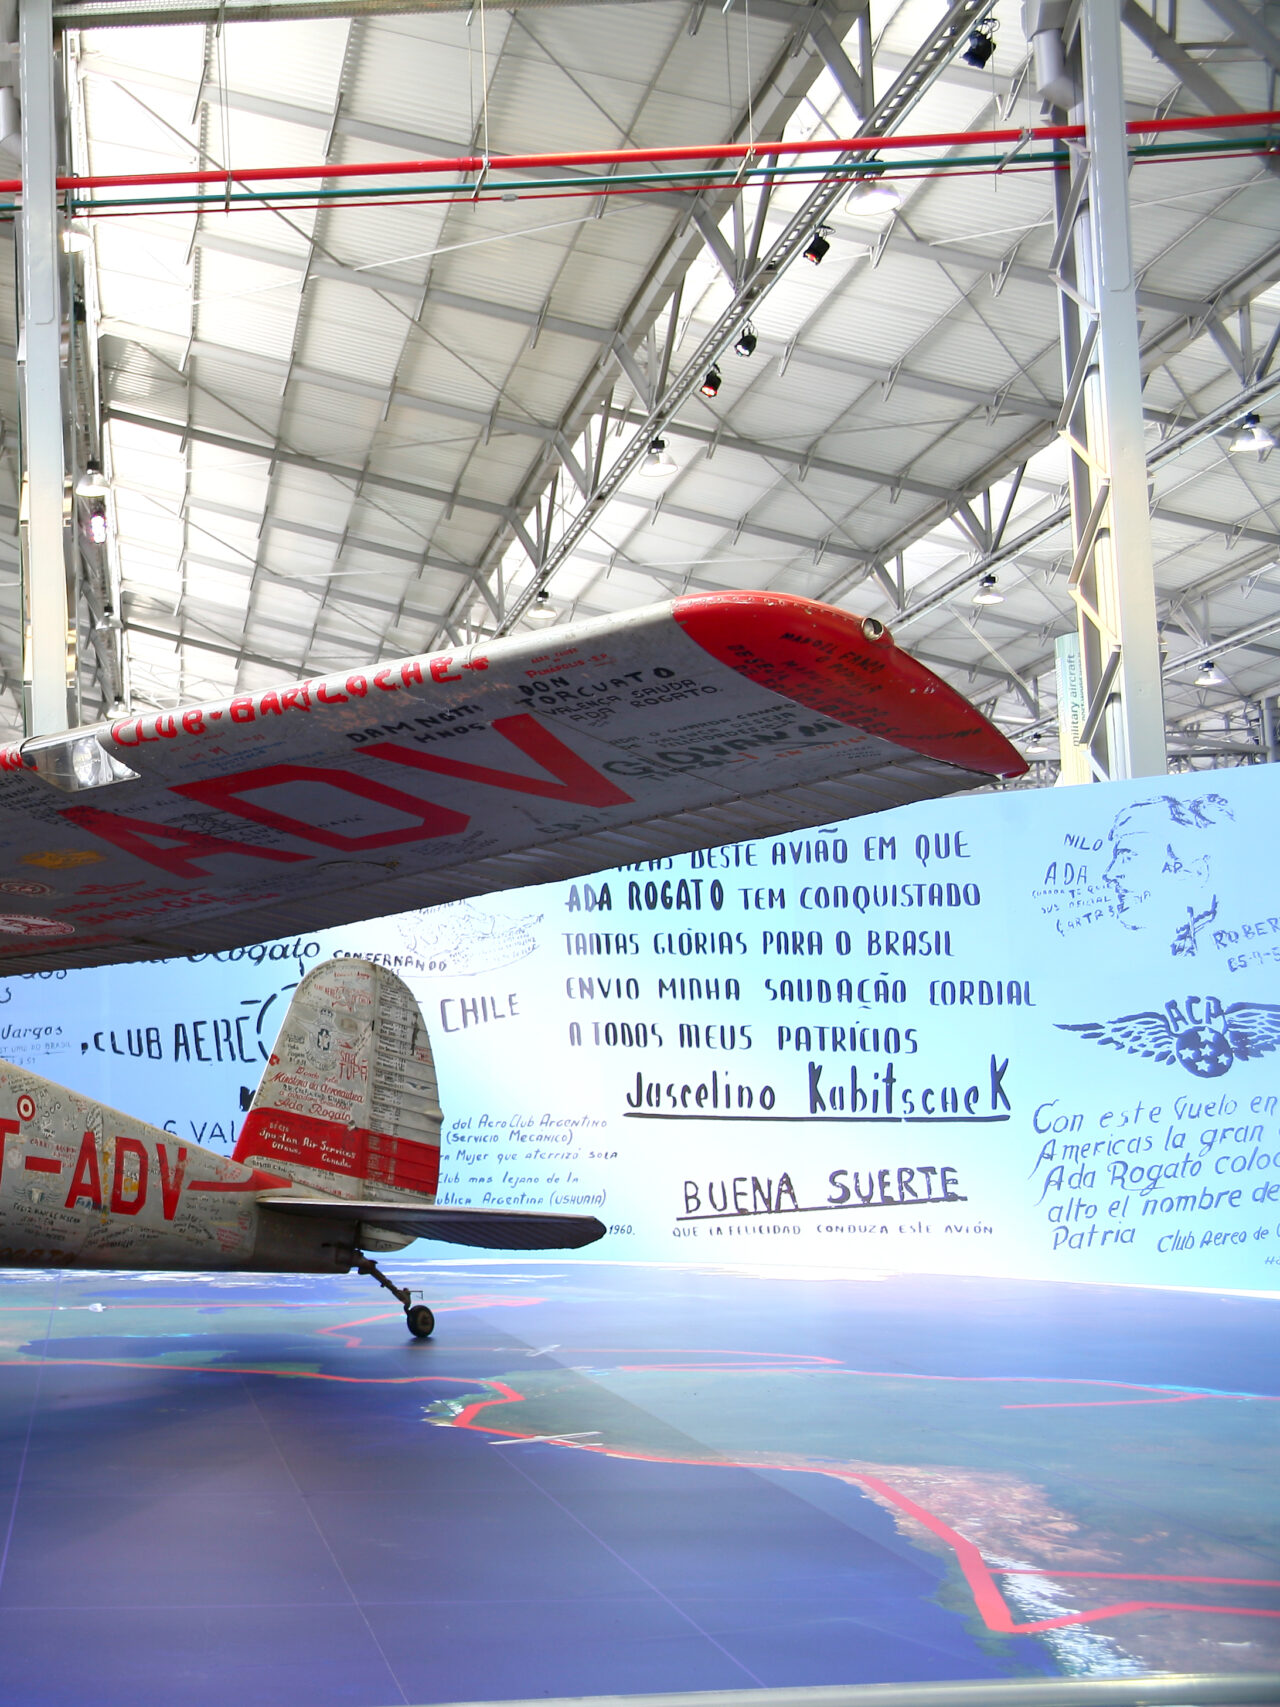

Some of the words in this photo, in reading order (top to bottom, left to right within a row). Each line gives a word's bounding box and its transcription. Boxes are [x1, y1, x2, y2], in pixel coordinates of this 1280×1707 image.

[516, 667, 675, 708] TORCUATO
[518, 677, 569, 696] DON
[1067, 654, 1077, 697] aircraft
[570, 708, 616, 722] ADA
[1071, 703, 1080, 747] military
[58, 713, 634, 879] ADV
[691, 845, 757, 870] DESTE
[772, 828, 847, 865] AVIÃO
[864, 836, 896, 861] EM
[915, 831, 971, 867] QUE
[1064, 834, 1103, 851] NILO
[1045, 862, 1087, 885] ADA
[565, 882, 612, 912] ADA
[629, 879, 723, 911] ROGATO
[738, 888, 785, 910] TEM
[800, 883, 980, 914] CONQUISTADO
[562, 933, 639, 955] TANTAS
[654, 927, 747, 955] GLÓRIAS
[763, 931, 822, 955] PARA
[835, 931, 851, 955] O
[868, 931, 955, 956] BRASIL
[566, 976, 640, 1000] ENVIO
[659, 977, 740, 1001] MINHA
[765, 972, 907, 1009] SAUDAÇÃO
[930, 980, 1036, 1006] CORDIAL
[440, 993, 520, 1032] CHILE
[1, 1024, 63, 1041] Vargas
[94, 1027, 162, 1059] CLUB
[592, 1022, 663, 1048] TODOS
[679, 1023, 752, 1050] MEUS
[779, 1021, 918, 1054] PATRÍCIOS
[274, 1099, 303, 1112] Ada
[309, 1104, 351, 1120] Rogato
[510, 1114, 533, 1127] Club
[1034, 1099, 1083, 1133] Con
[1100, 1100, 1161, 1127] este
[1250, 1094, 1277, 1113] en
[457, 1150, 488, 1165] Mujer
[498, 1153, 518, 1164] que
[1028, 1134, 1152, 1180] Americas
[1164, 1126, 1185, 1150] la
[1199, 1124, 1263, 1157] gran
[546, 1173, 560, 1183] de
[684, 1173, 799, 1214] BUENA
[827, 1166, 960, 1204] SUERTE
[1034, 1164, 1096, 1206] Ada
[1108, 1152, 1202, 1196] Rogato
[1048, 1198, 1097, 1222] alto
[1108, 1195, 1129, 1217] el
[1142, 1186, 1241, 1216] nombre
[1252, 1181, 1279, 1202] de
[673, 1226, 698, 1237] QUE
[817, 1224, 888, 1234] CONDUZA
[1053, 1222, 1135, 1250] Patria
[1157, 1230, 1194, 1252] Club
[1200, 1231, 1246, 1248] Aereo
[1253, 1226, 1268, 1240] de
